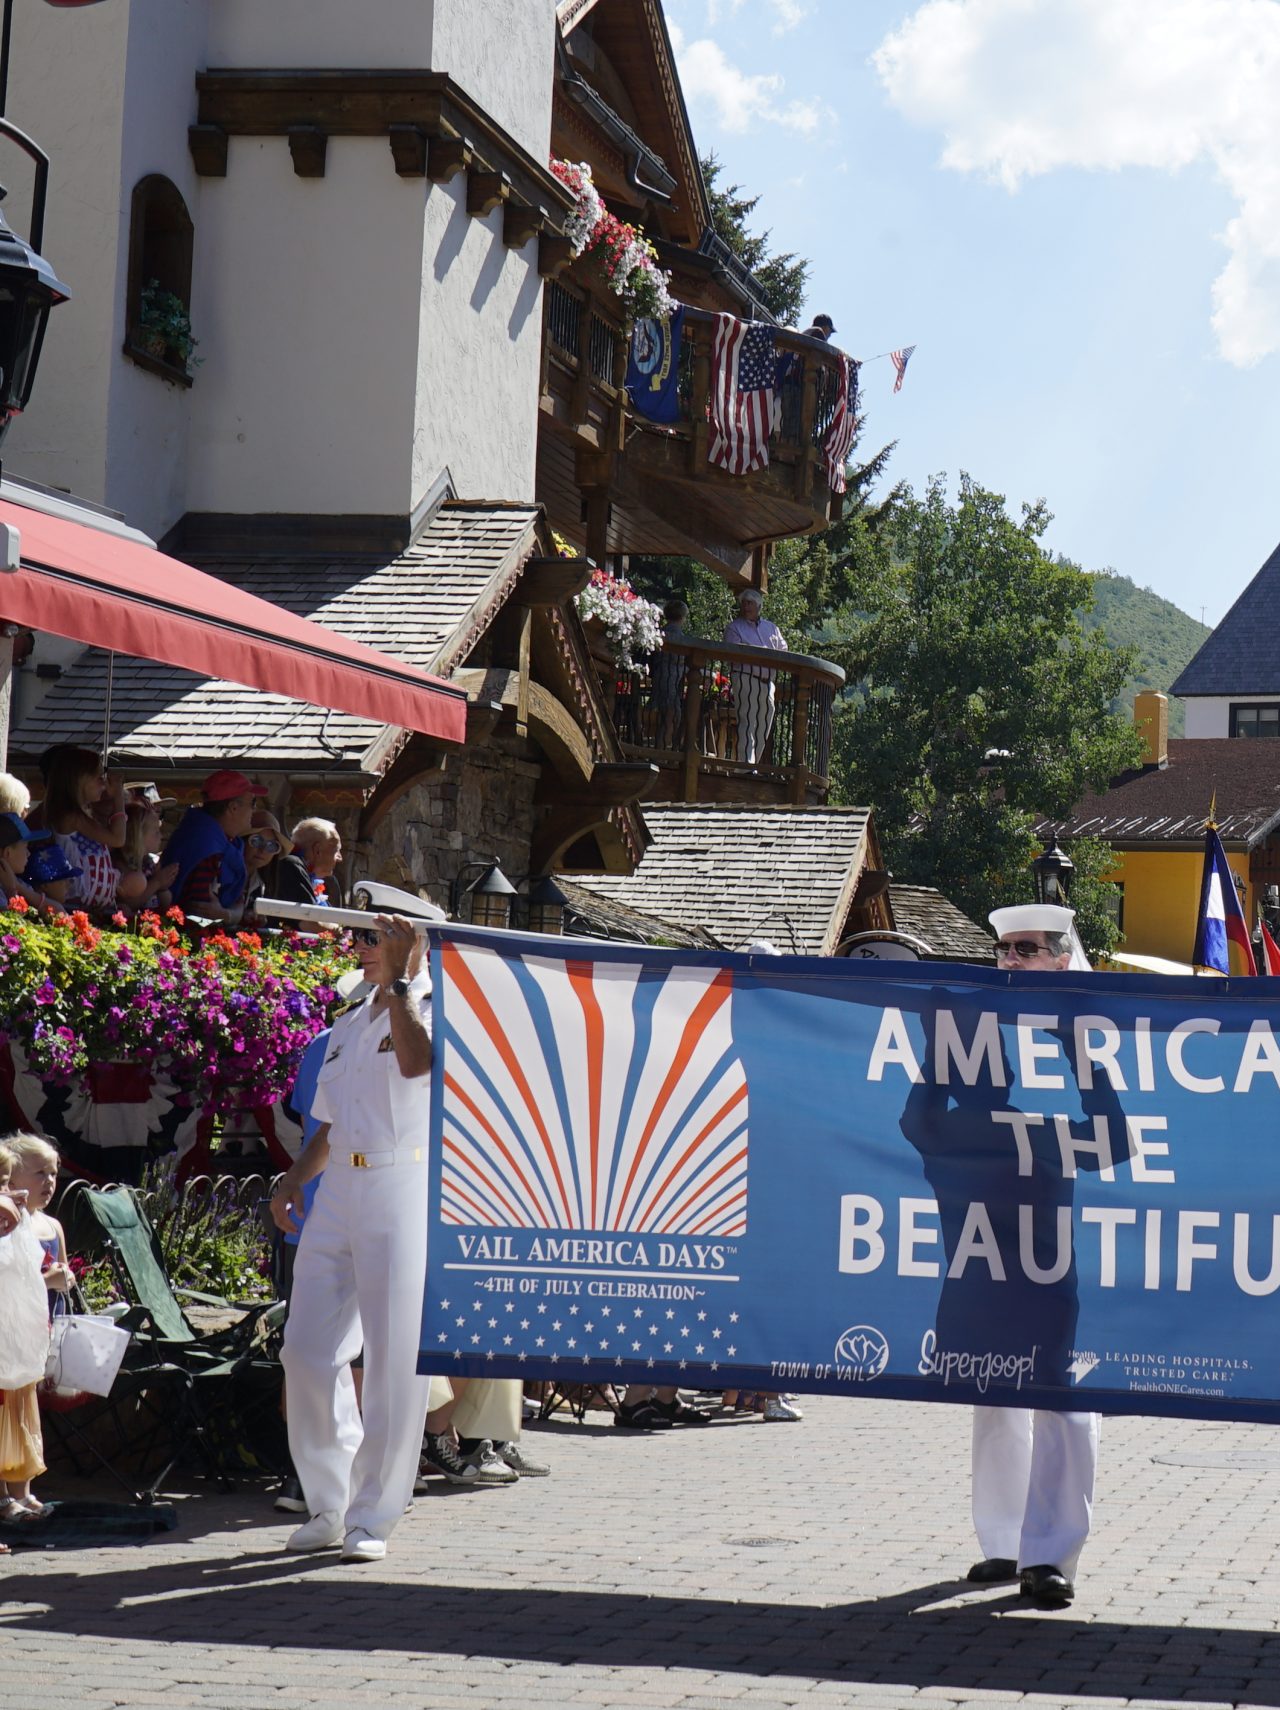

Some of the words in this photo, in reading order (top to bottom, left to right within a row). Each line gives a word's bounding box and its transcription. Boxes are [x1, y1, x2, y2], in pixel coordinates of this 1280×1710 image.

[991, 1110, 1176, 1184] THE
[457, 1235, 519, 1260] VAIL
[527, 1238, 650, 1266] AMERICA
[520, 1279, 539, 1294] OF
[543, 1280, 583, 1296] JULY
[918, 1329, 1037, 1393] Supergoop!
[1105, 1352, 1166, 1364] LEADING
[770, 1361, 810, 1378] TOWN
[815, 1363, 831, 1379] OF
[835, 1364, 866, 1381] VAIL
[1124, 1366, 1186, 1379] TRUSTED
[1129, 1381, 1225, 1396] HealthONECares.com
